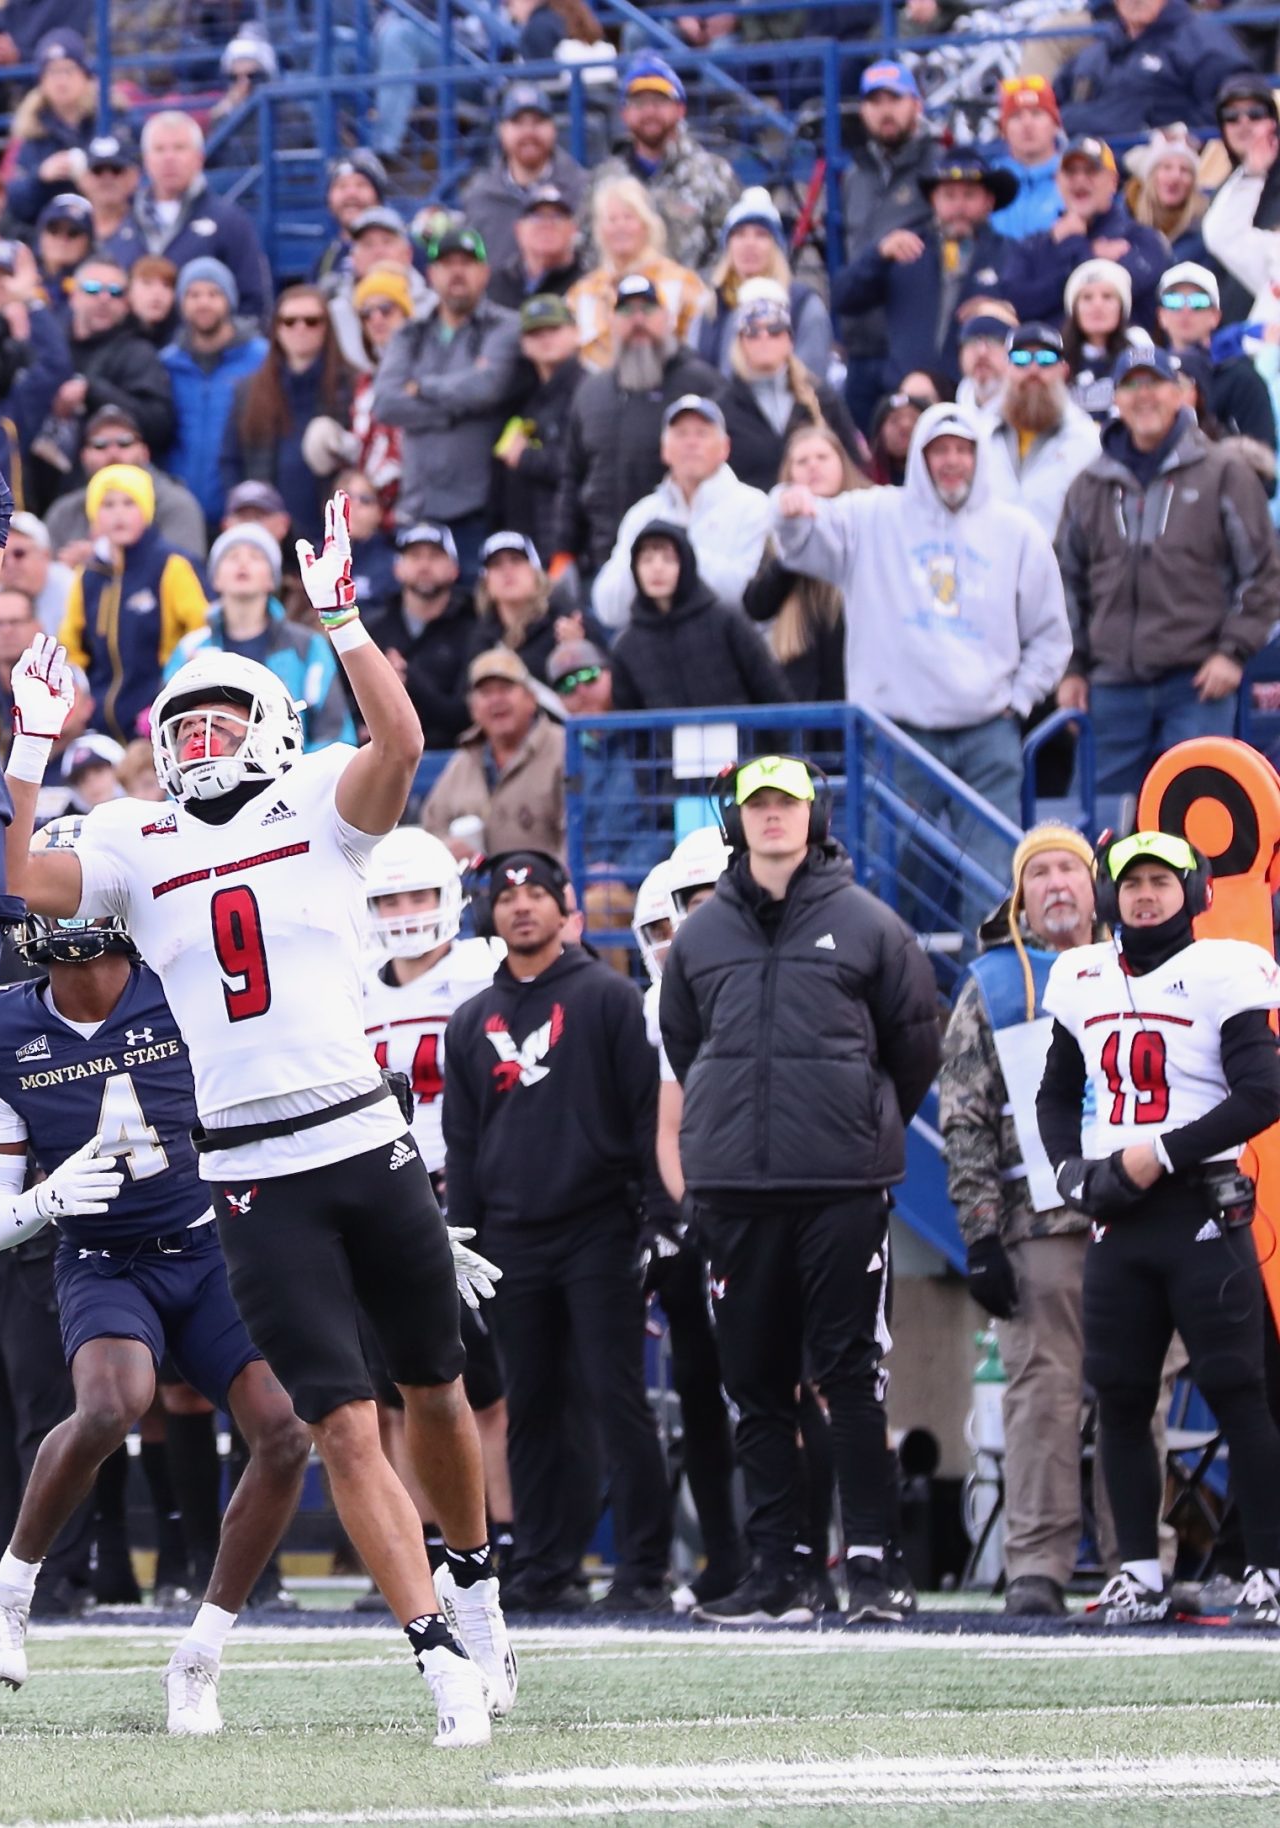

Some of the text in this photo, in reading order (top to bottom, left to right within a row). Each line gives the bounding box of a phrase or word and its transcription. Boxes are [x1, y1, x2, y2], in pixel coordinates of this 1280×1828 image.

[260, 811, 297, 827] adidas
[214, 840, 310, 877] WASHINGTON
[211, 884, 271, 1023] 9
[18, 1040, 180, 1090] MONTANA STATE
[1101, 1031, 1170, 1126] 19
[95, 1072, 169, 1182] 4
[389, 1150, 418, 1171] adidas
